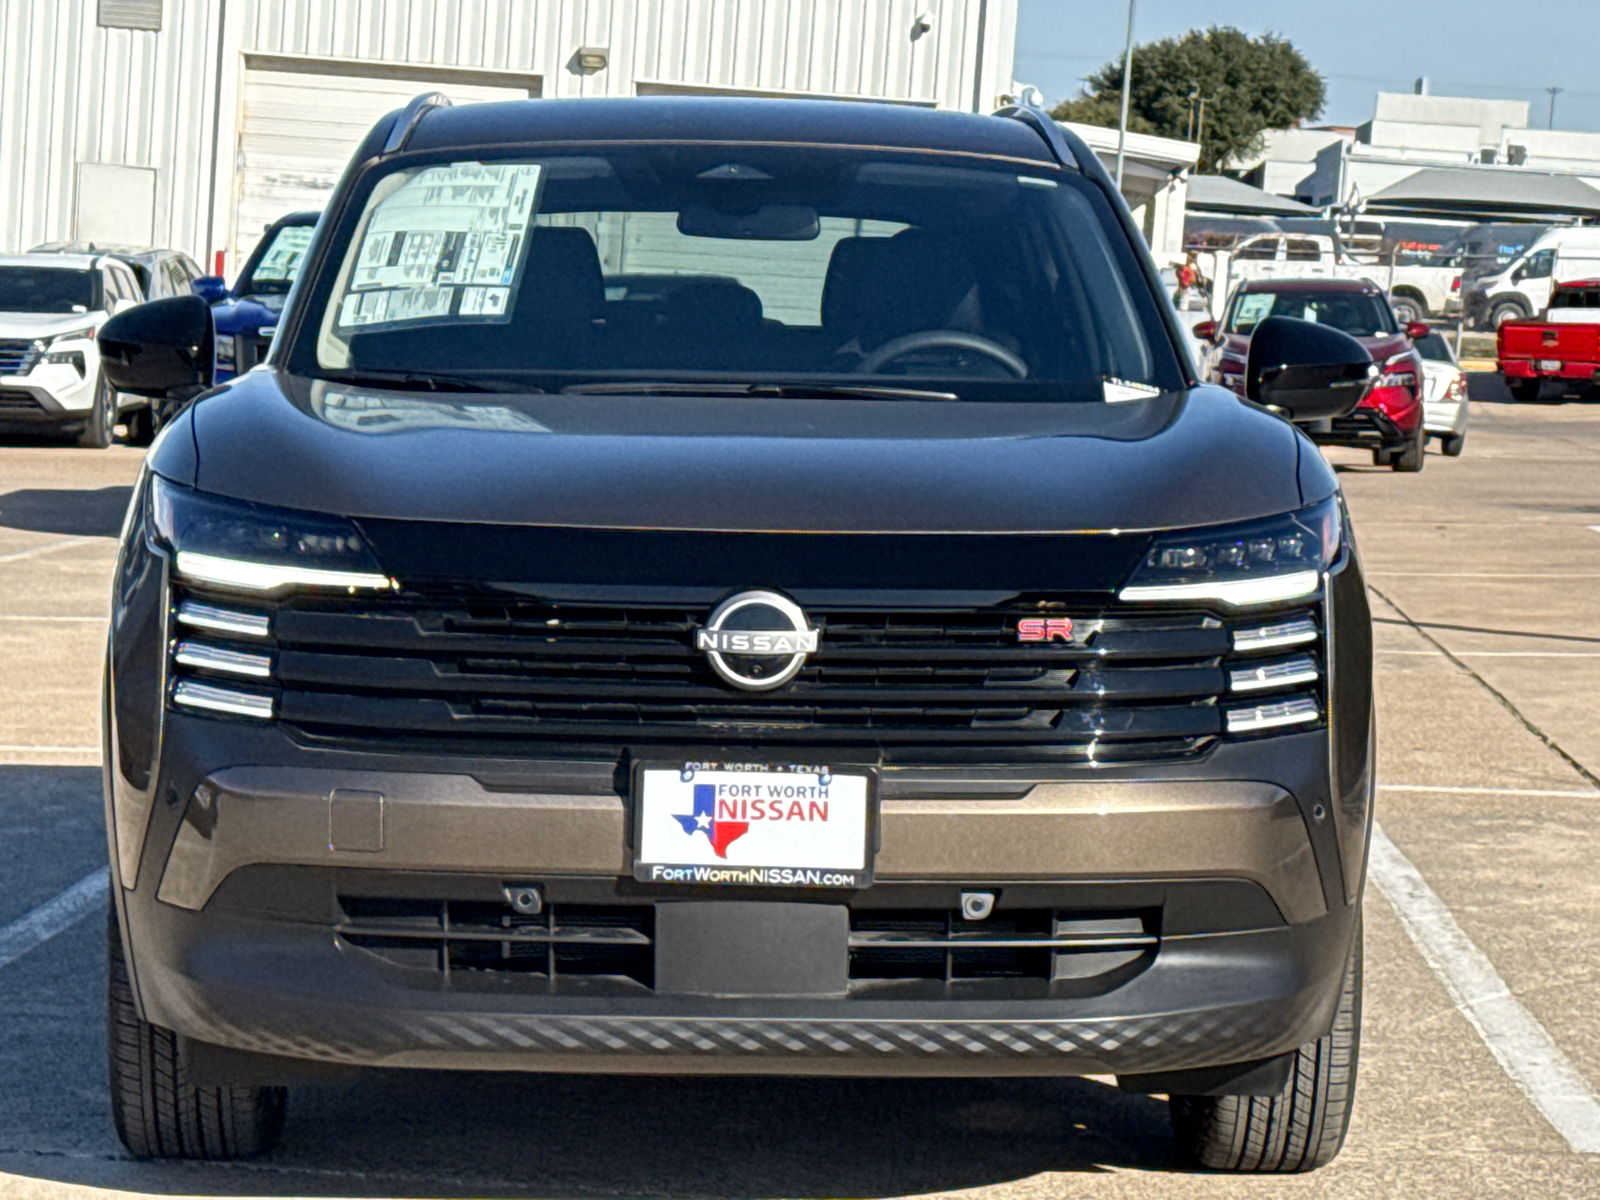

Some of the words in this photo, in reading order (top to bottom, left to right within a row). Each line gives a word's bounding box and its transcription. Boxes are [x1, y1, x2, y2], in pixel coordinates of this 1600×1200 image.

[1018, 618, 1073, 641] SR
[699, 632, 813, 652] NISSAN
[685, 762, 718, 772] FORT
[724, 763, 769, 772] WORTH
[789, 764, 829, 774] TEXAS
[718, 784, 763, 797] FORT
[767, 785, 829, 799] WORTH
[718, 799, 829, 822] NISSAN
